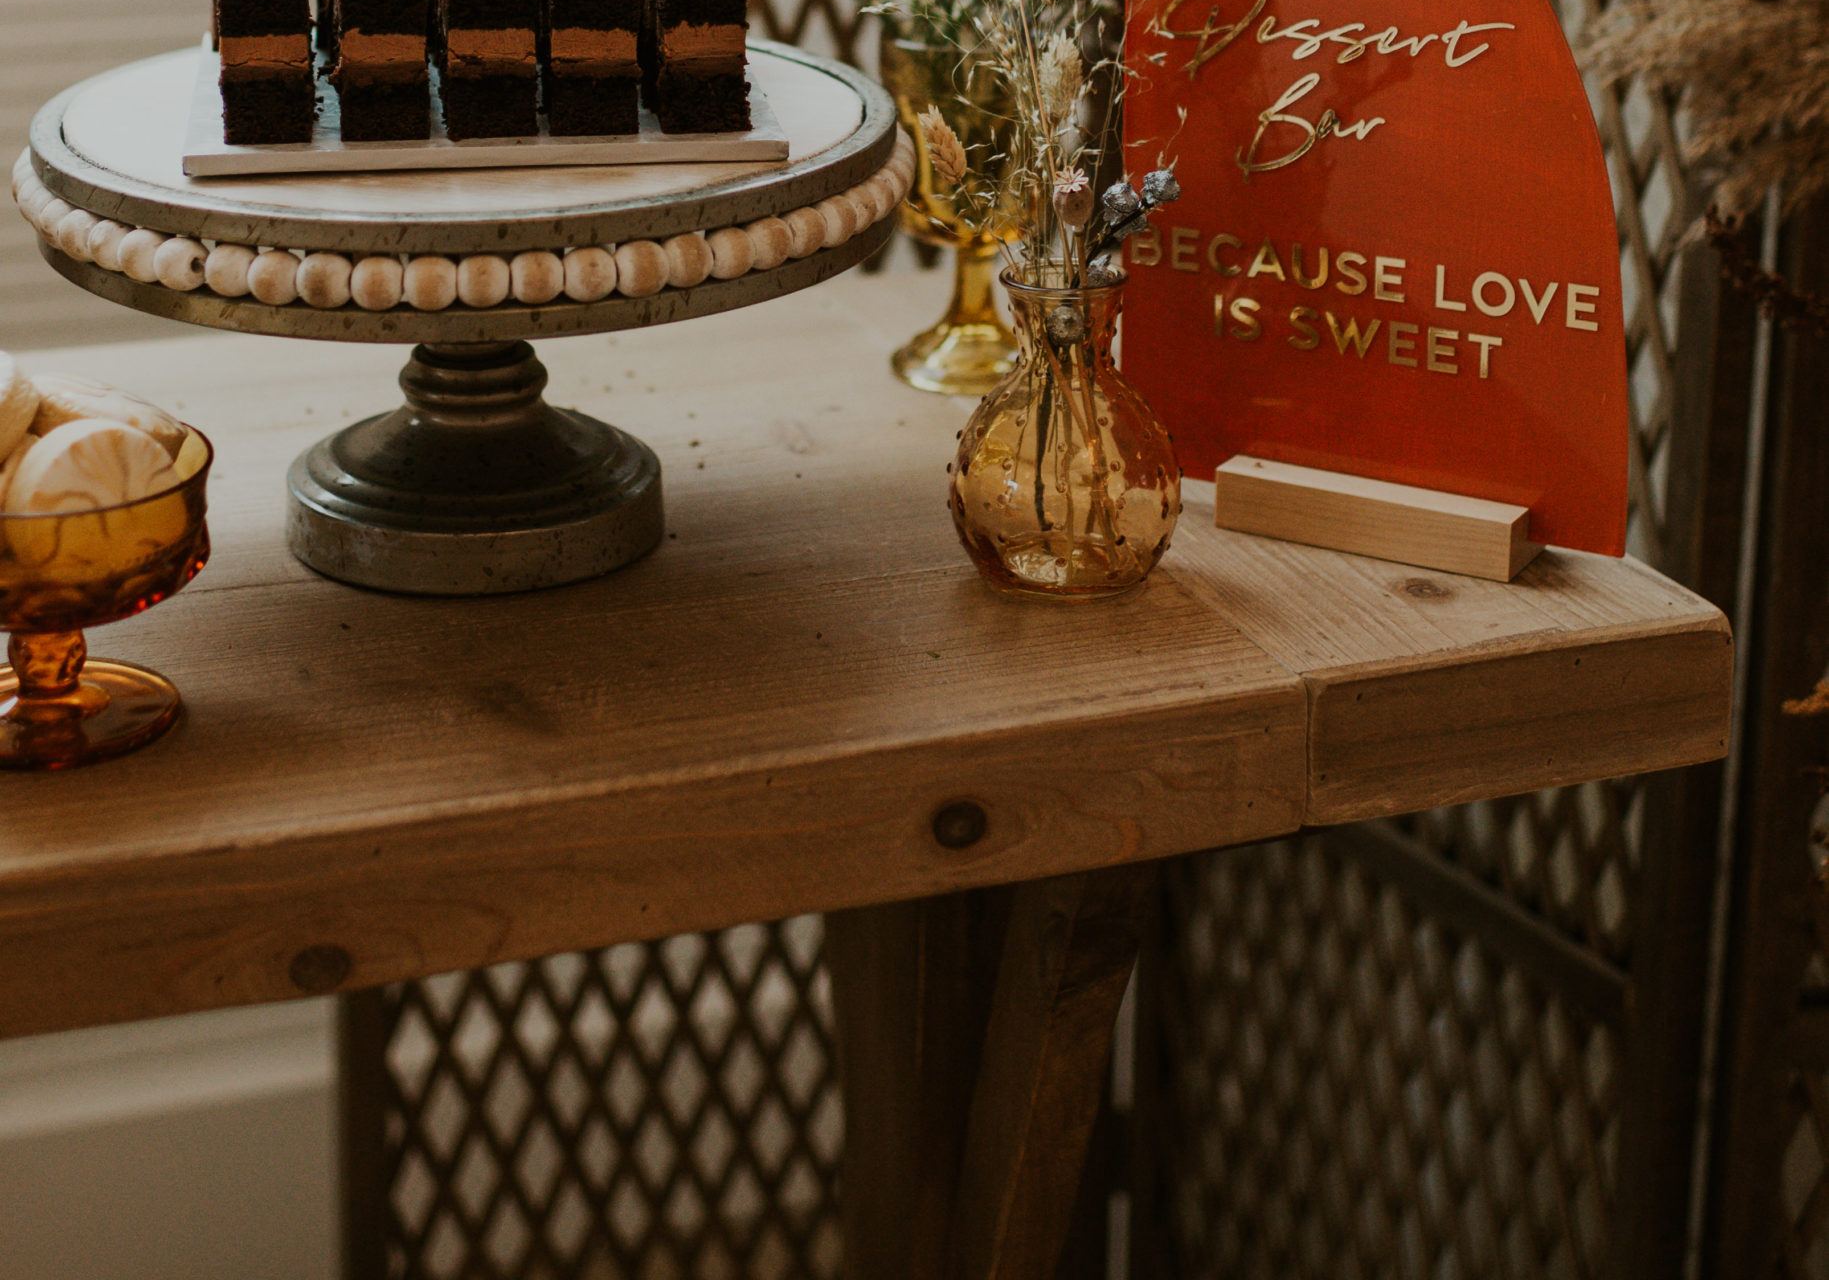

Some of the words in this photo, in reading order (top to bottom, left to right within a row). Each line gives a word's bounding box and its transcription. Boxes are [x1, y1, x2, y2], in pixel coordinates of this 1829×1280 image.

[1235, 72, 1386, 183] Bar
[1130, 224, 1407, 304] BECAUSE
[1434, 264, 1600, 332] LOVE
[1213, 293, 1263, 341] IS
[1287, 306, 1503, 379] SWEET
